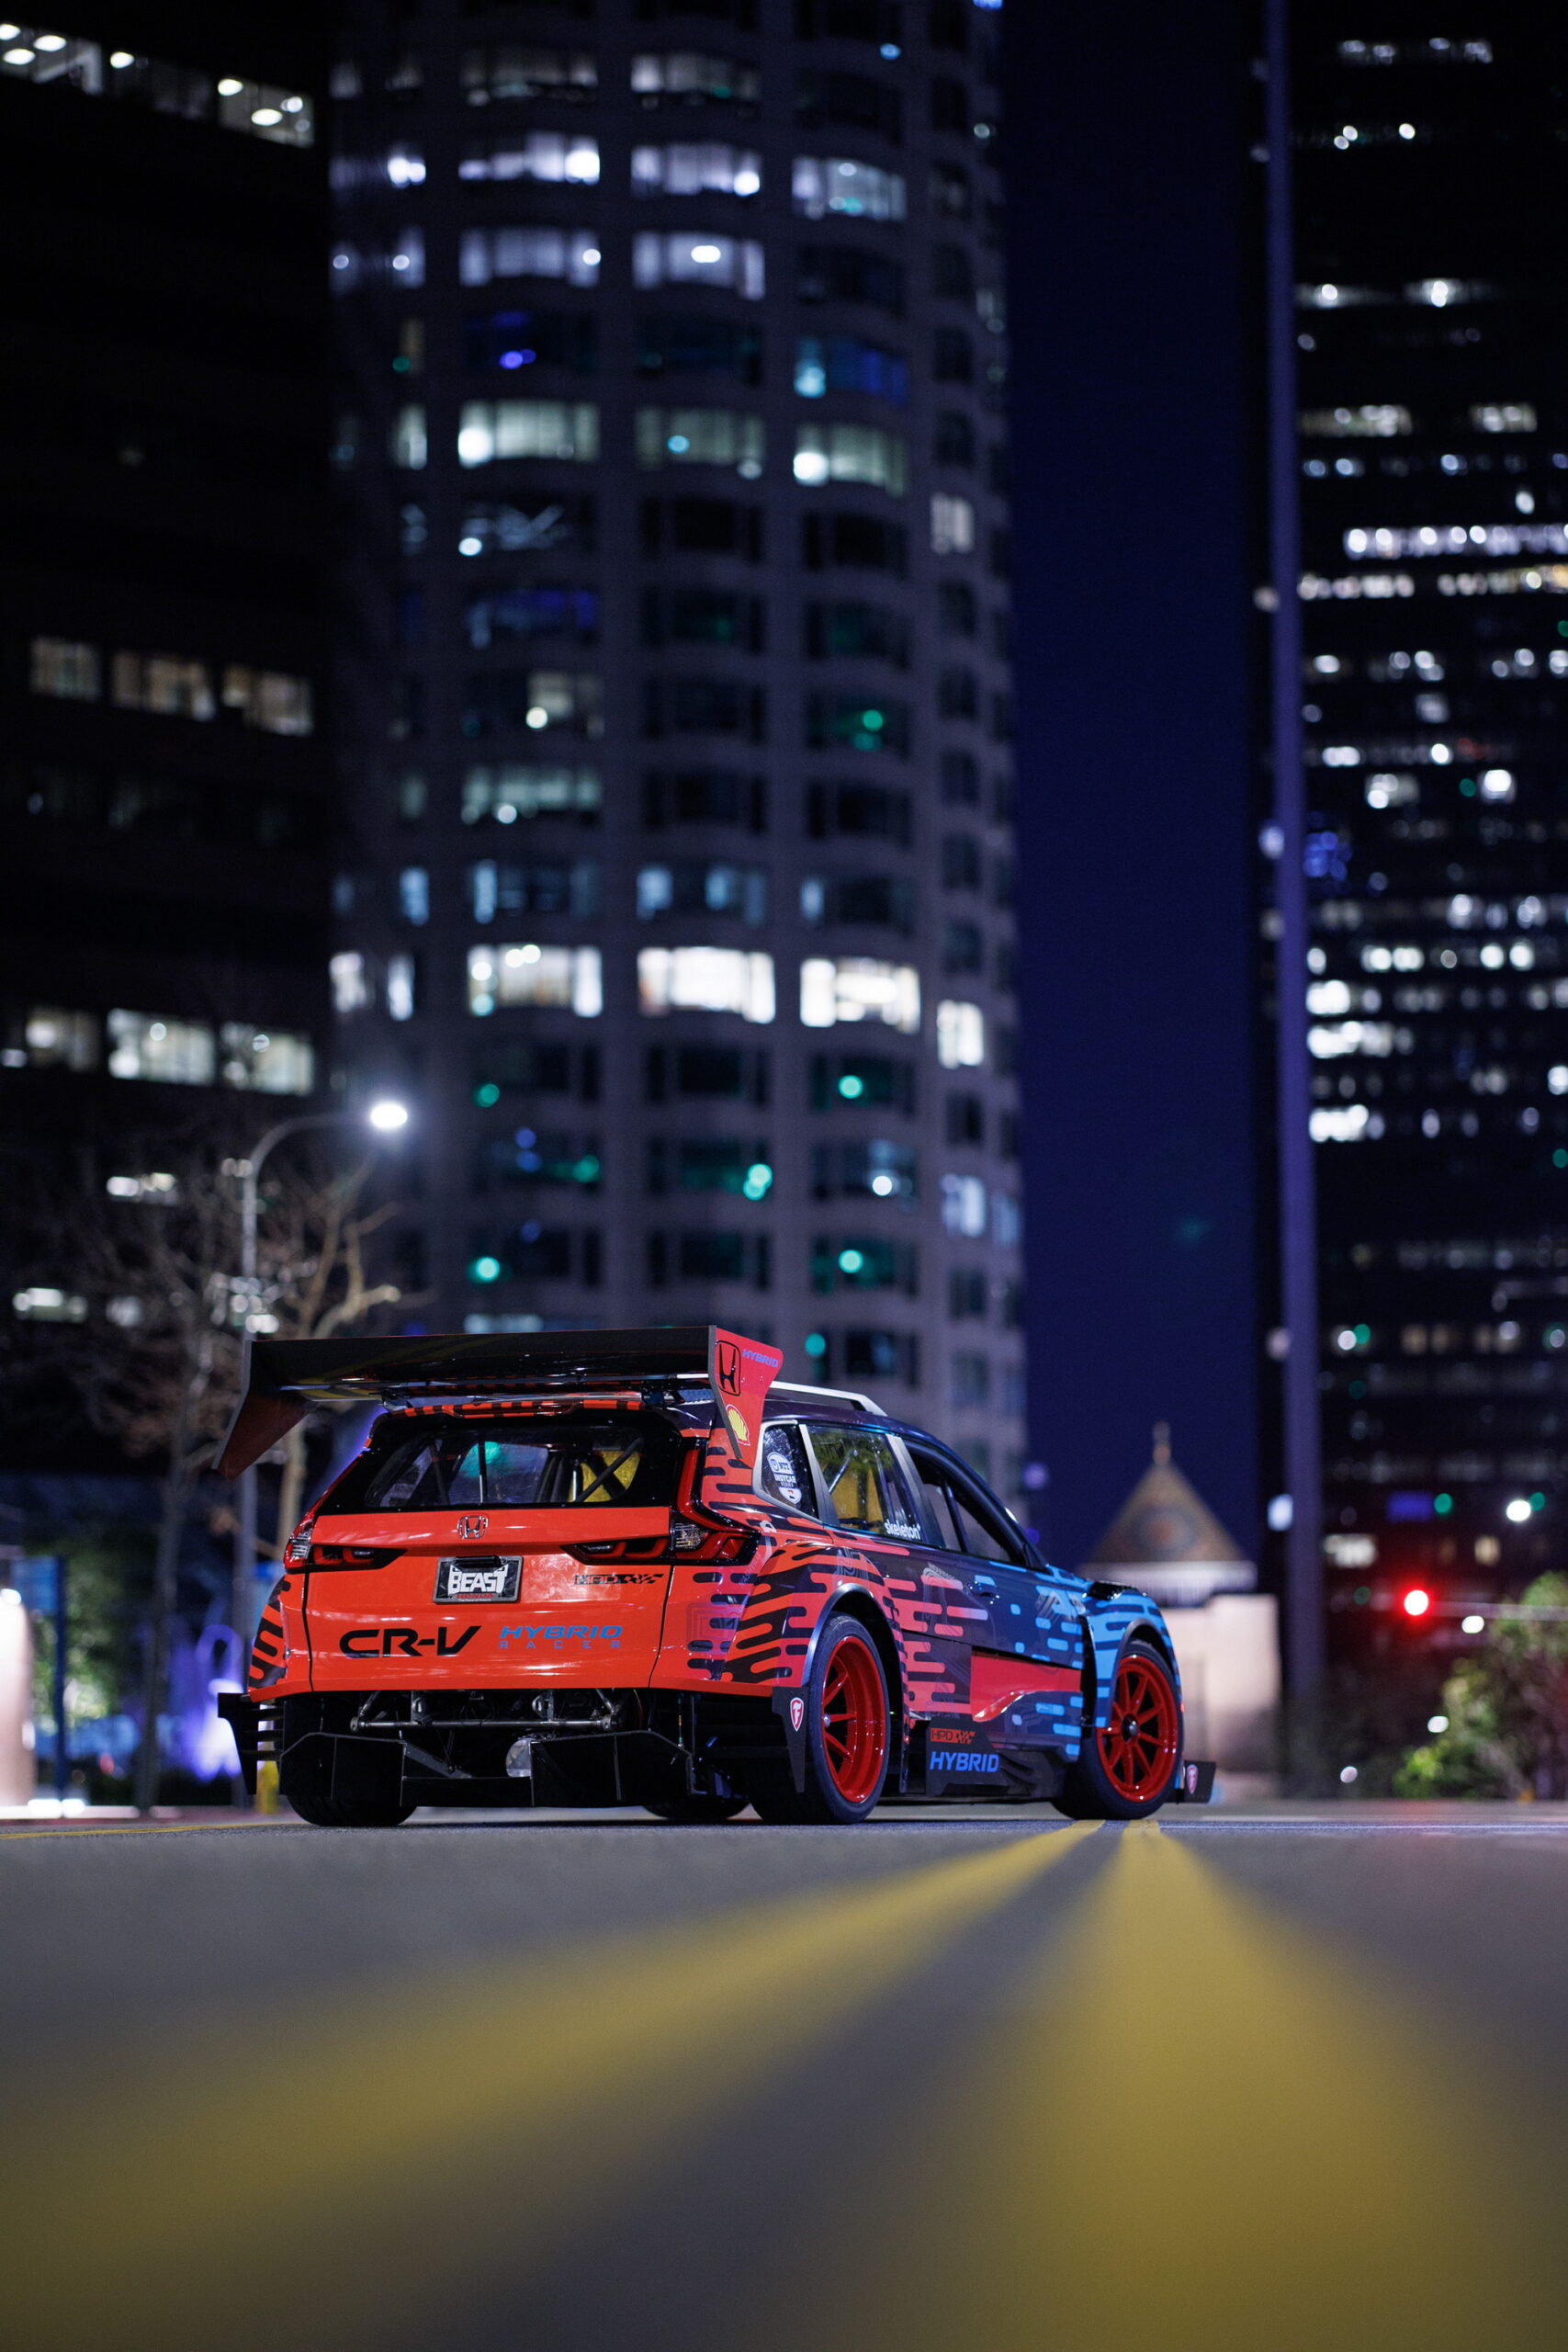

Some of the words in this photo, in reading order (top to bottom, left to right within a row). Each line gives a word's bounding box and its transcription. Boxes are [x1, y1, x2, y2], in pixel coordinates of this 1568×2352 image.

[742, 1349, 779, 1367] HYBRID
[448, 1565, 508, 1595] BEAST
[500, 1625, 623, 1638] HYBRID
[339, 1625, 482, 1658] CR-V
[500, 1640, 622, 1649] RACER
[931, 1729, 953, 1741] HPD
[929, 1751, 999, 1772] HYBRID
